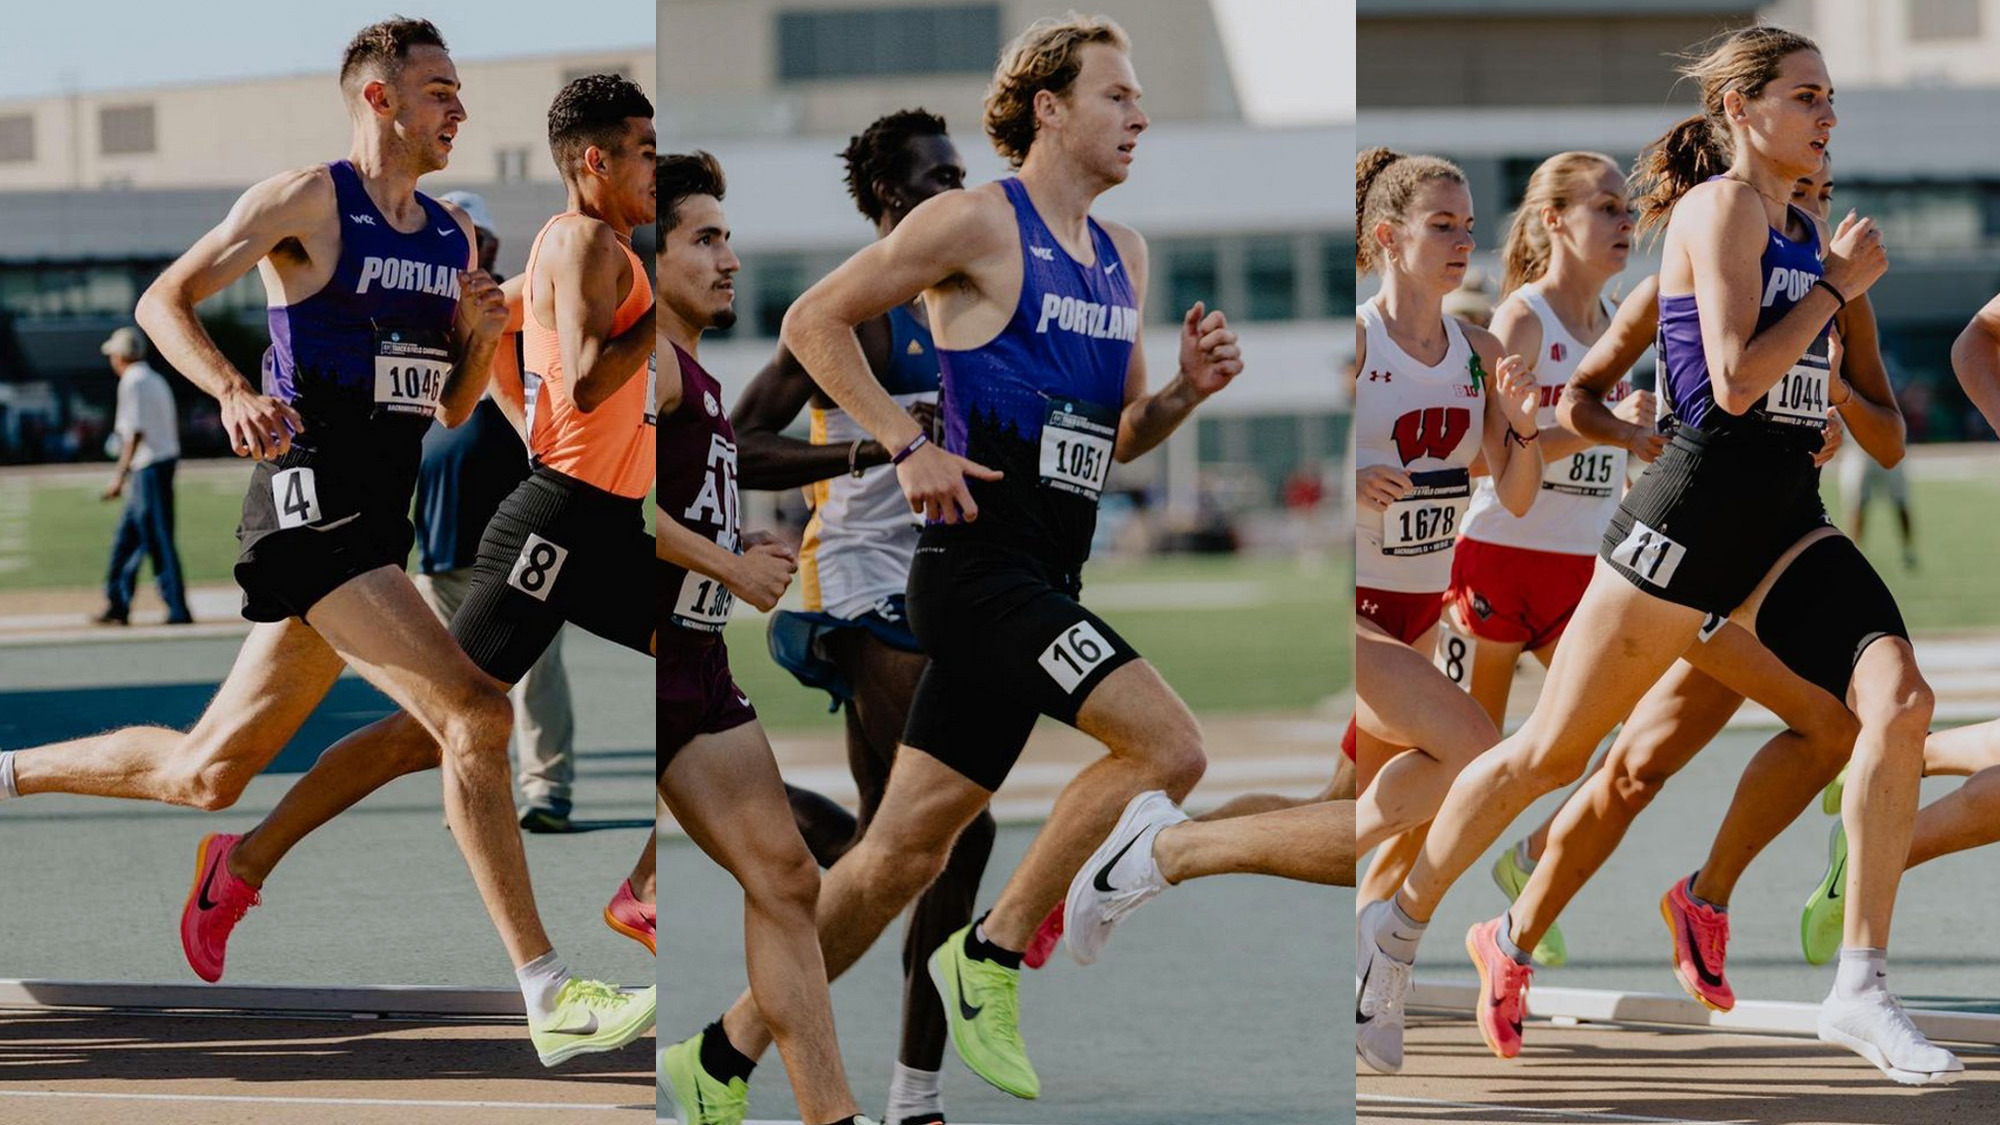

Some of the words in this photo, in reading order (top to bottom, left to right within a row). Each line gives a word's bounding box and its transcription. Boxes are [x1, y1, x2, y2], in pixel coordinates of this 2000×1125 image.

[355, 256, 463, 302] PORTLAN
[1761, 267, 1820, 307] PORT
[1036, 292, 1139, 343] PORTLAN
[390, 366, 440, 402] 1046
[1778, 373, 1823, 413] 1044
[1390, 407, 1470, 468] W
[1056, 440, 1103, 482] 1051
[1569, 452, 1613, 483] 815
[283, 471, 310, 521] 4
[1400, 506, 1455, 542] 1678
[520, 543, 557, 591] 8
[1629, 532, 1671, 579] 11
[1053, 627, 1101, 676] 16
[1447, 637, 1466, 683] 8
